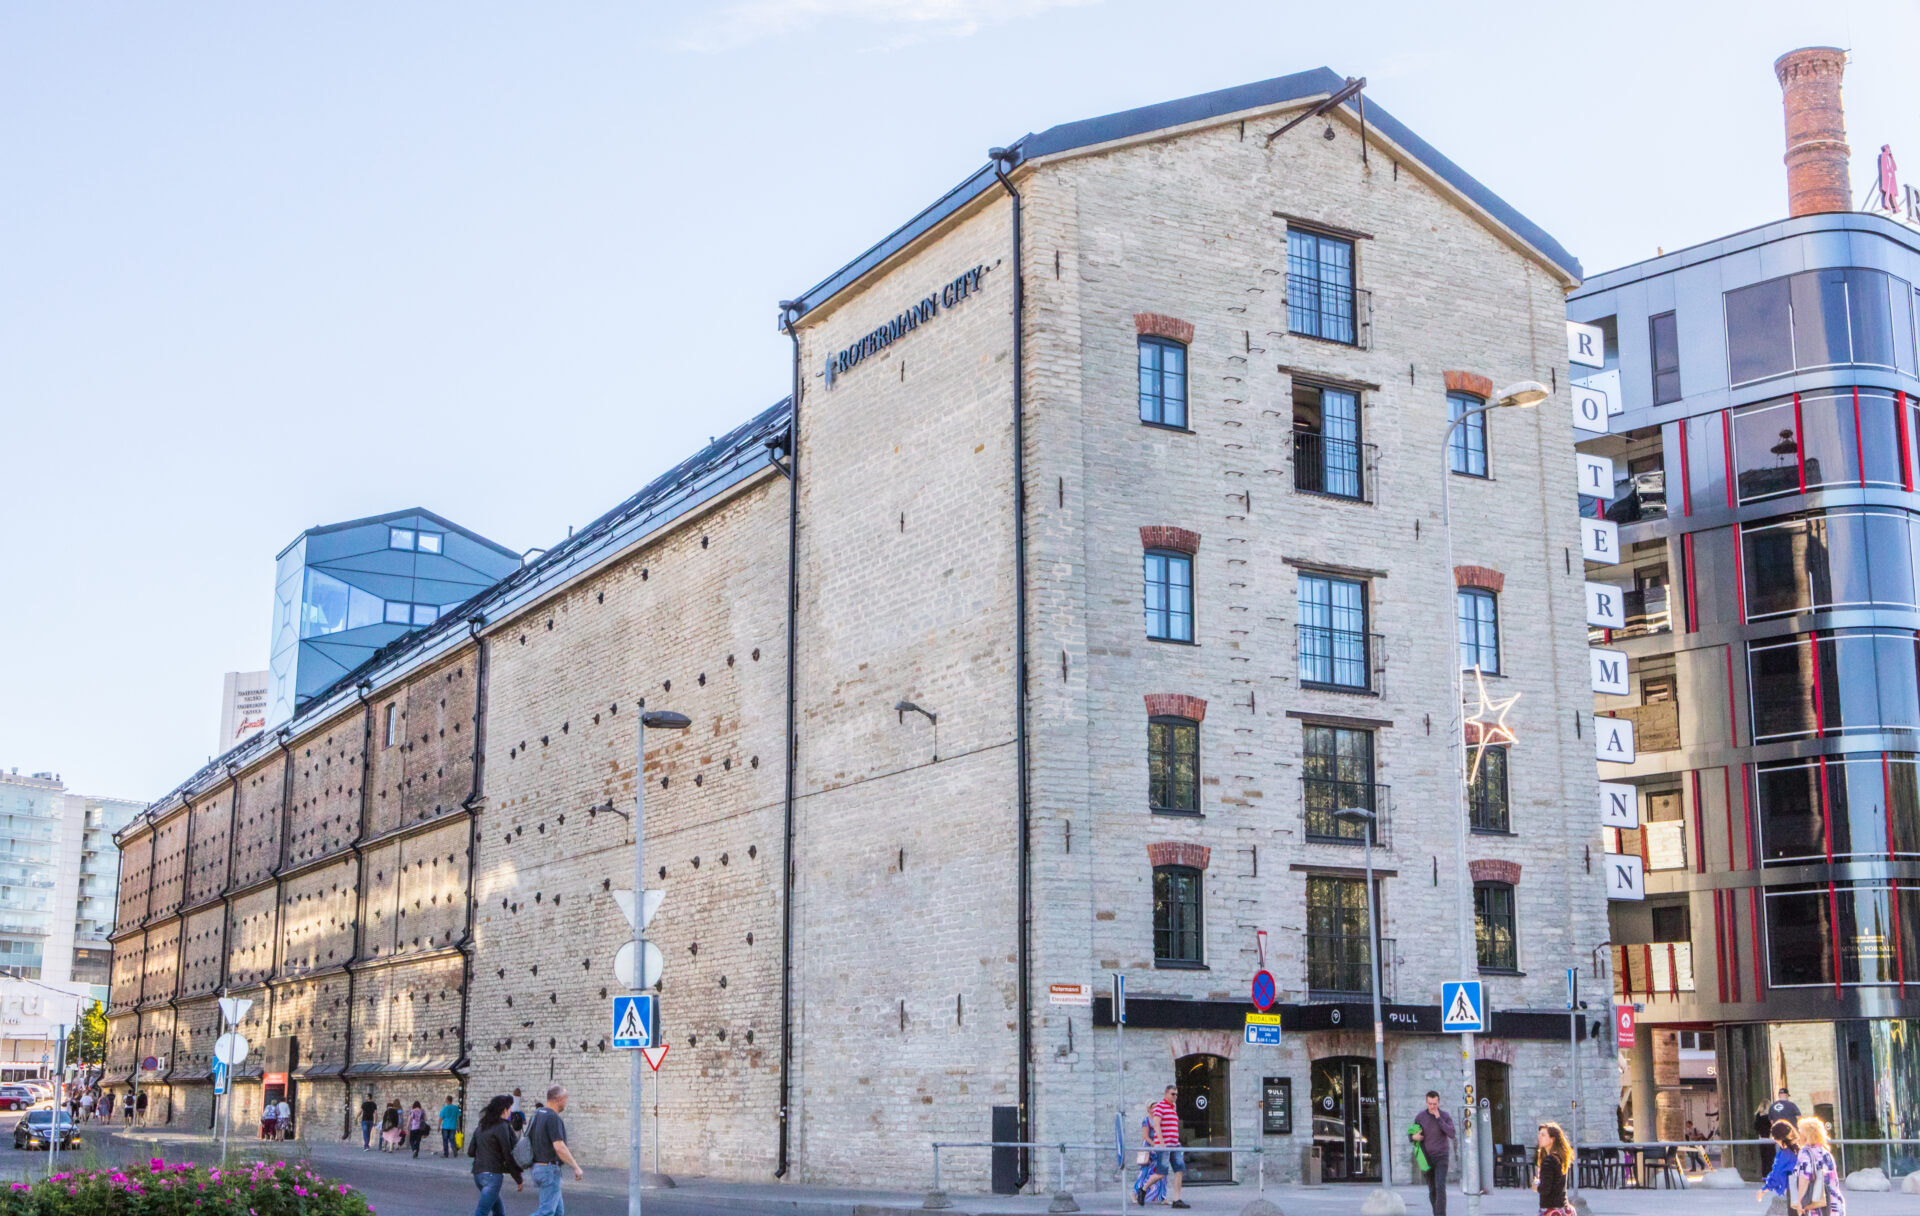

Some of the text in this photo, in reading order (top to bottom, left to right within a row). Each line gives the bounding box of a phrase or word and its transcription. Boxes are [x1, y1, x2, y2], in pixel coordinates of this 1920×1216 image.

[837, 264, 983, 374] ROTERMANN CITY
[1577, 332, 1634, 891] ROTERMANN
[1389, 1012, 1418, 1023] PULL
